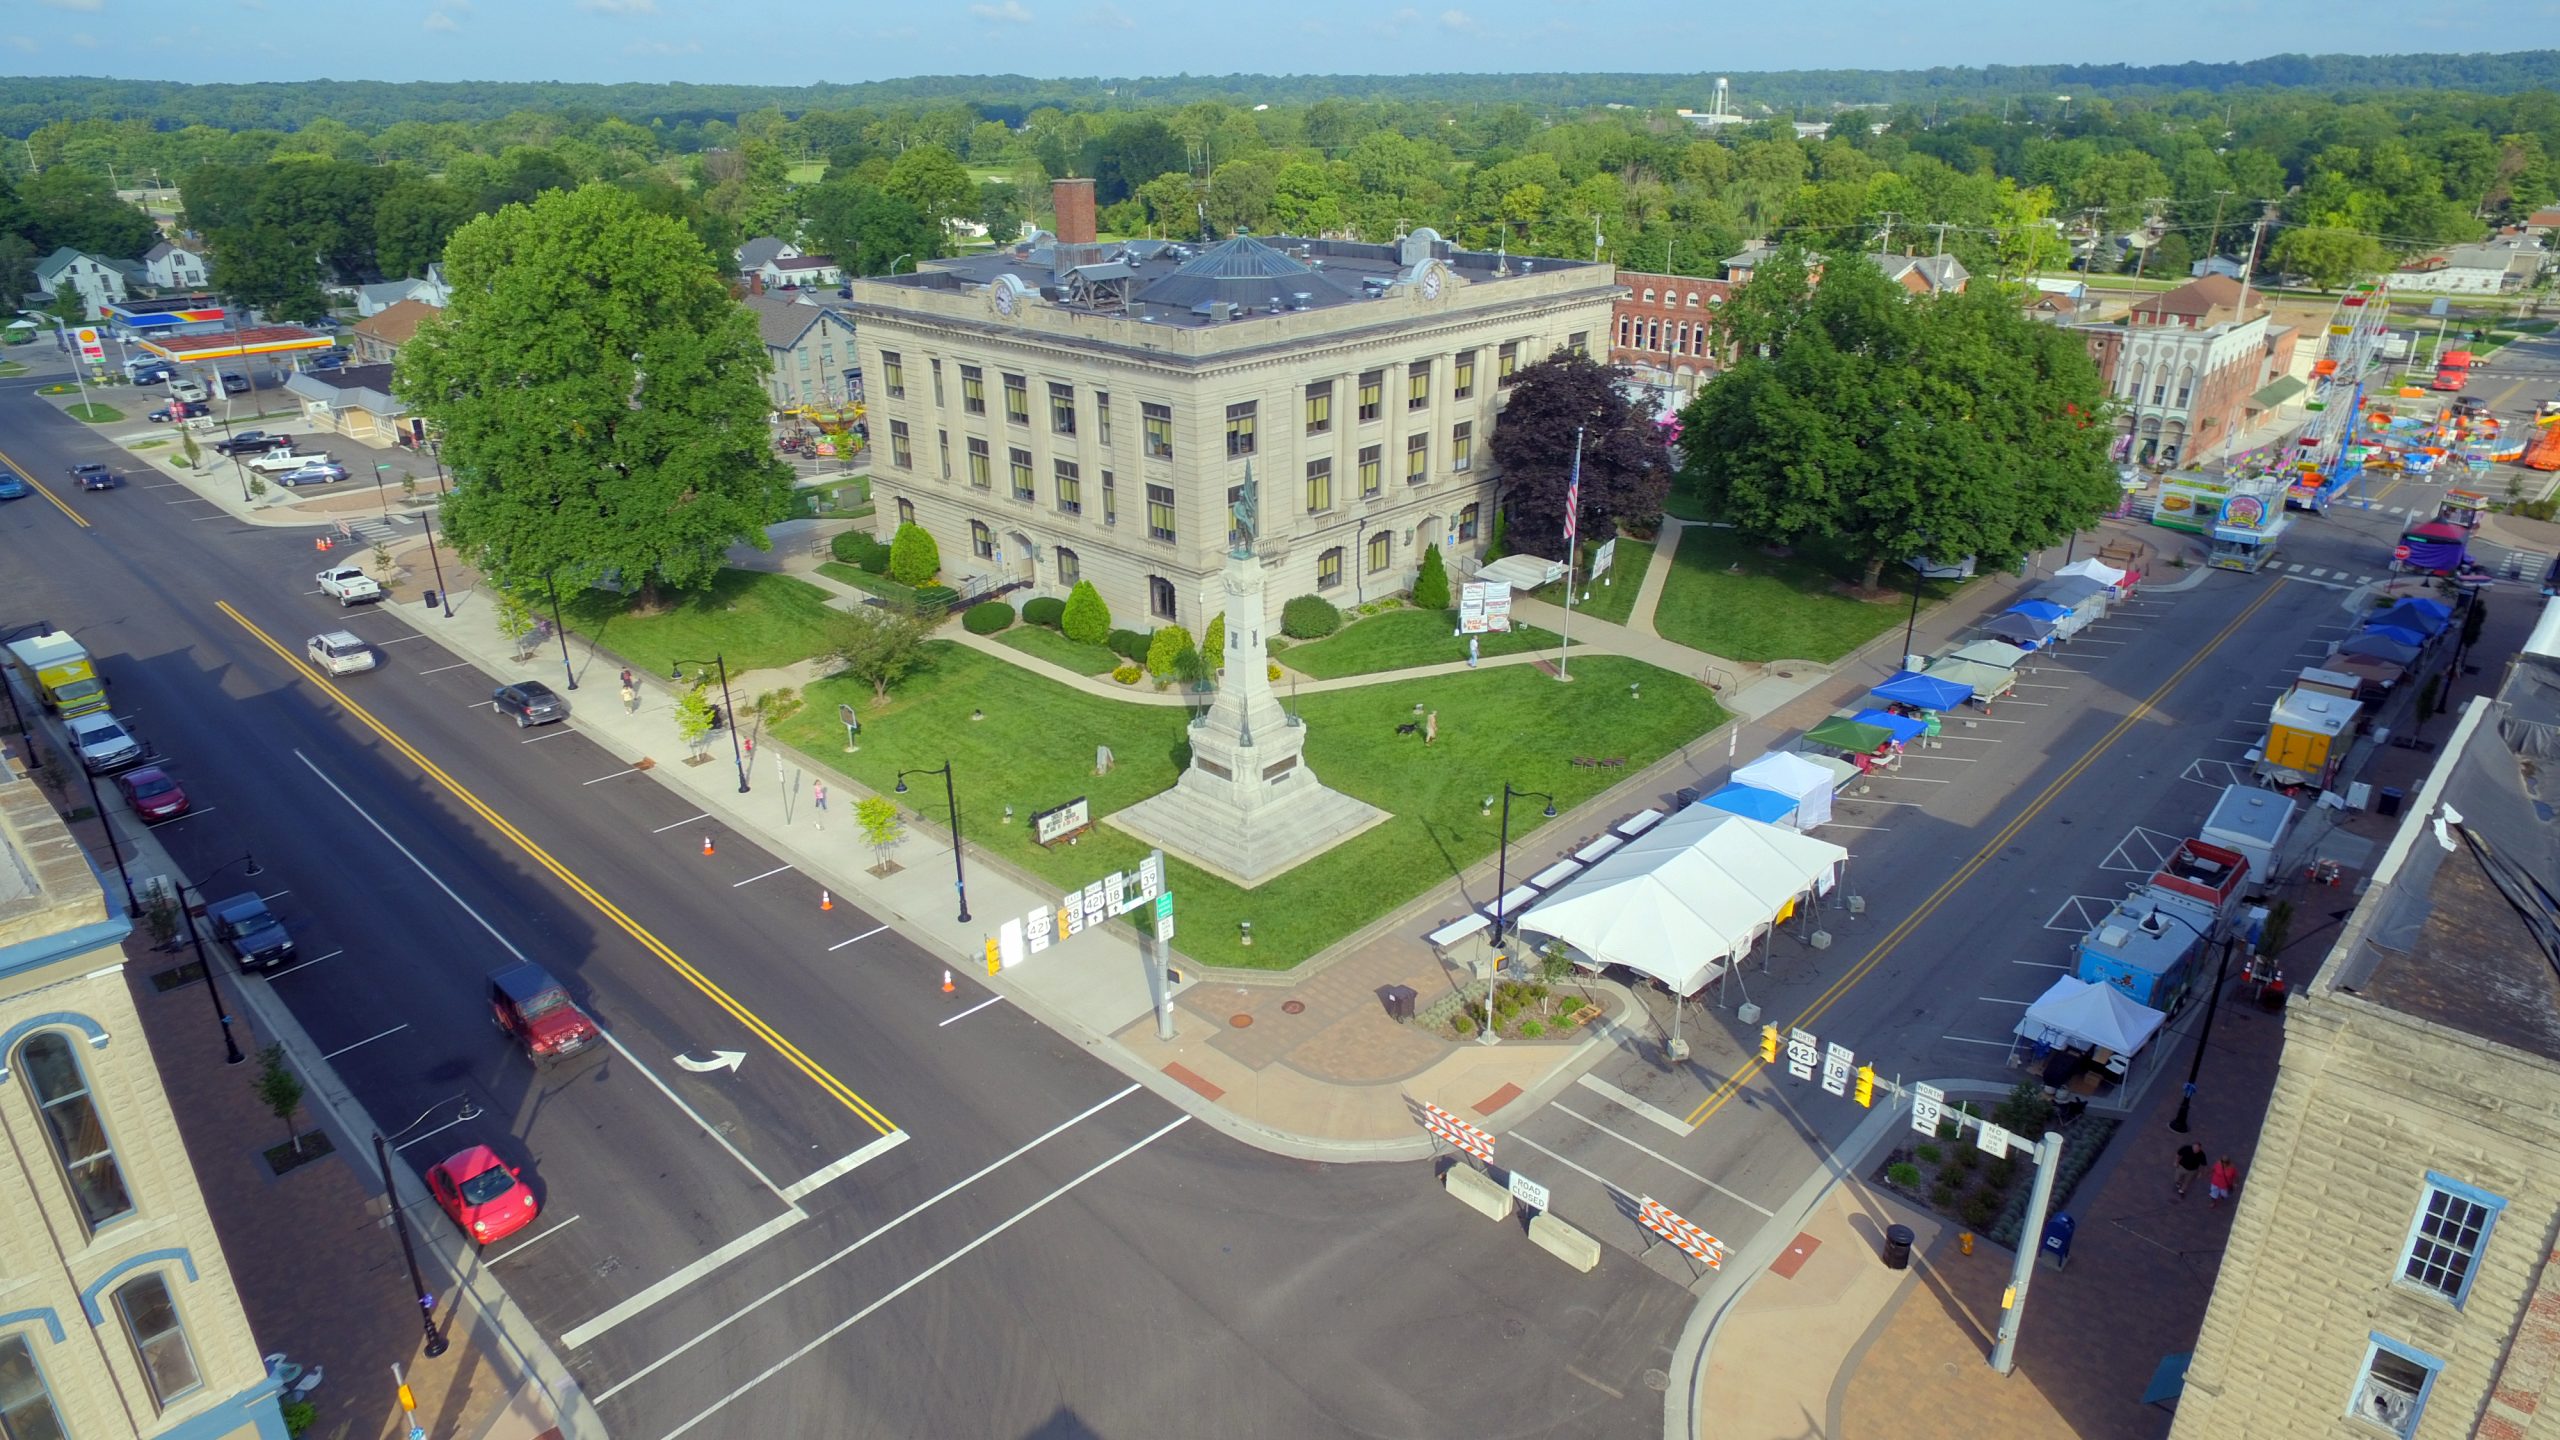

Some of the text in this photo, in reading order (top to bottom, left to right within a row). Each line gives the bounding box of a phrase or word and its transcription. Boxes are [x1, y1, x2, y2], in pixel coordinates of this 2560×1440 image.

[1144, 873, 1155, 886] 39
[1087, 895, 1103, 908] 421
[1110, 889, 1120, 901] 18
[1069, 909, 1079, 920] 18
[1030, 921, 1049, 935] 421
[1792, 1031, 1815, 1044] NORTH
[1790, 1046, 1814, 1063] 421
[1832, 1046, 1850, 1059] WEST
[1830, 1063, 1844, 1078] 18
[1917, 1085, 1942, 1099] NORTH
[1916, 1103, 1937, 1118] 39
[1986, 1132, 2002, 1142] TURN
[1988, 1126, 2002, 1136] NO
[1986, 1144, 1998, 1153] RED
[1988, 1138, 1997, 1146] ON
[1518, 1179, 1541, 1195] ROAD
[1512, 1185, 1544, 1207] CLOSED
